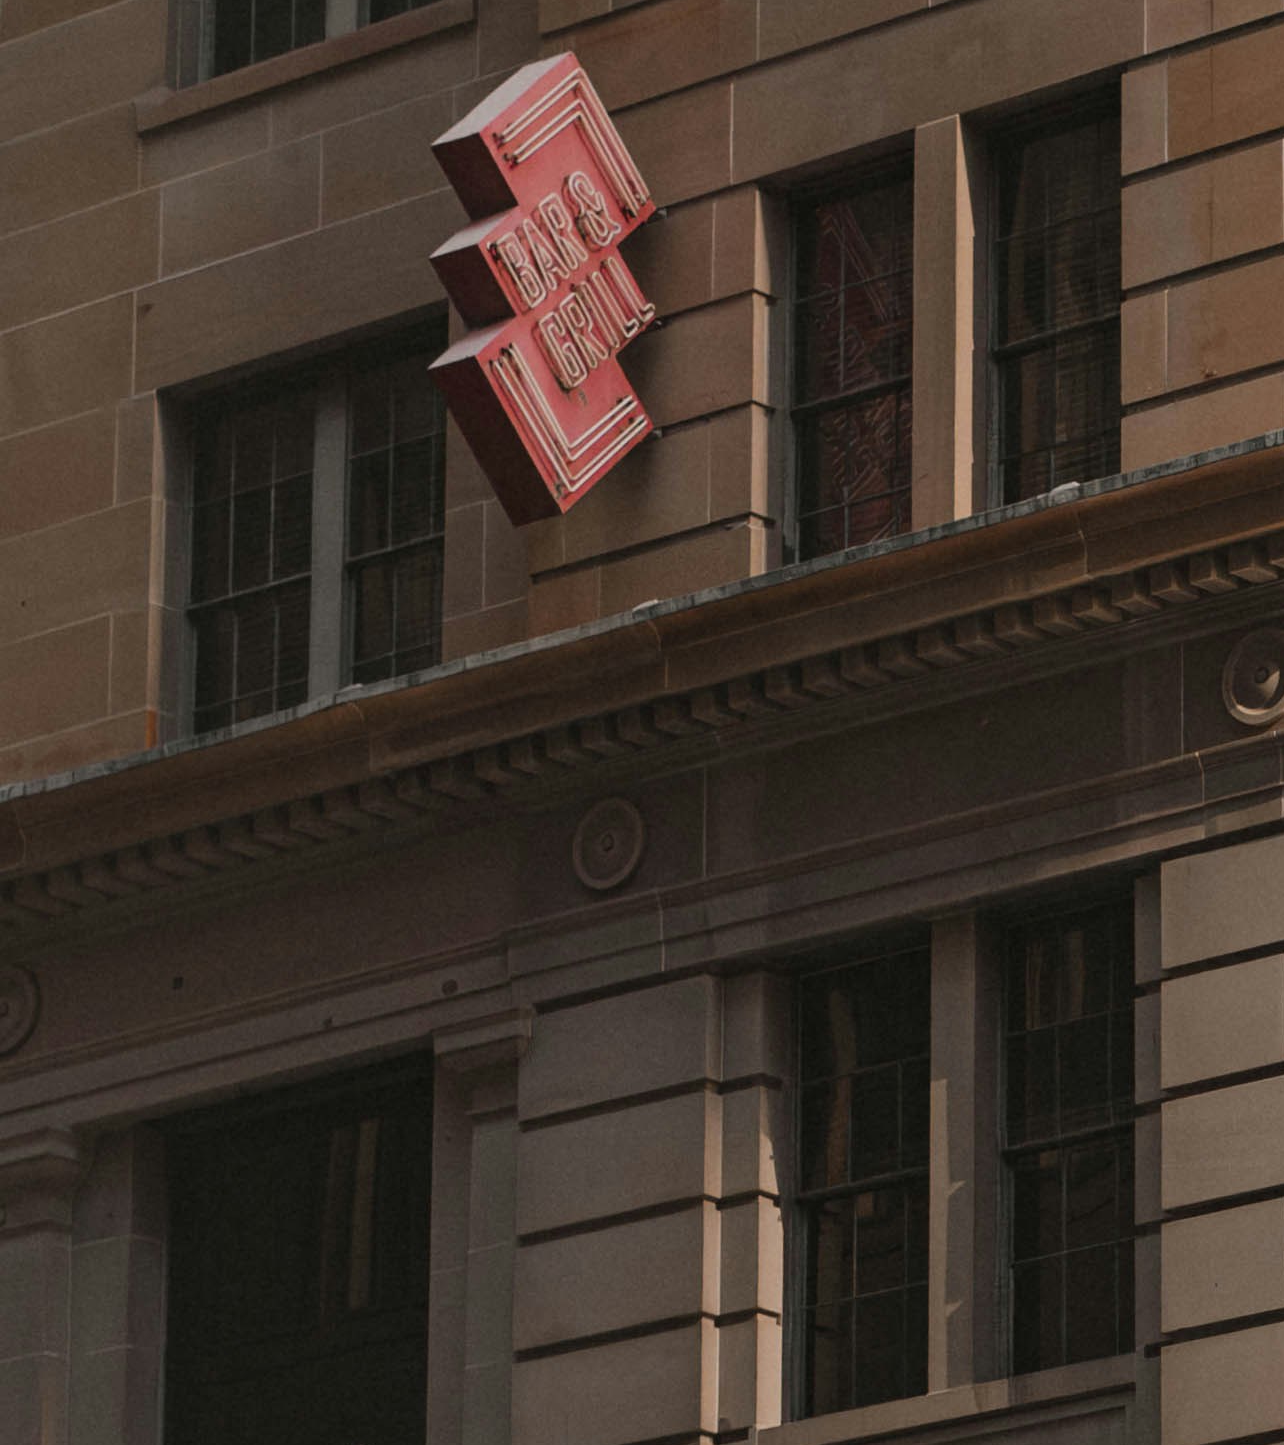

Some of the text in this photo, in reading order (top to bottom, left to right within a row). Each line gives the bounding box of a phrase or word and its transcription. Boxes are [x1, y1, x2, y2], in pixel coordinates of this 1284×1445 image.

[492, 169, 622, 309] BAR &
[535, 257, 656, 391] GRILL
